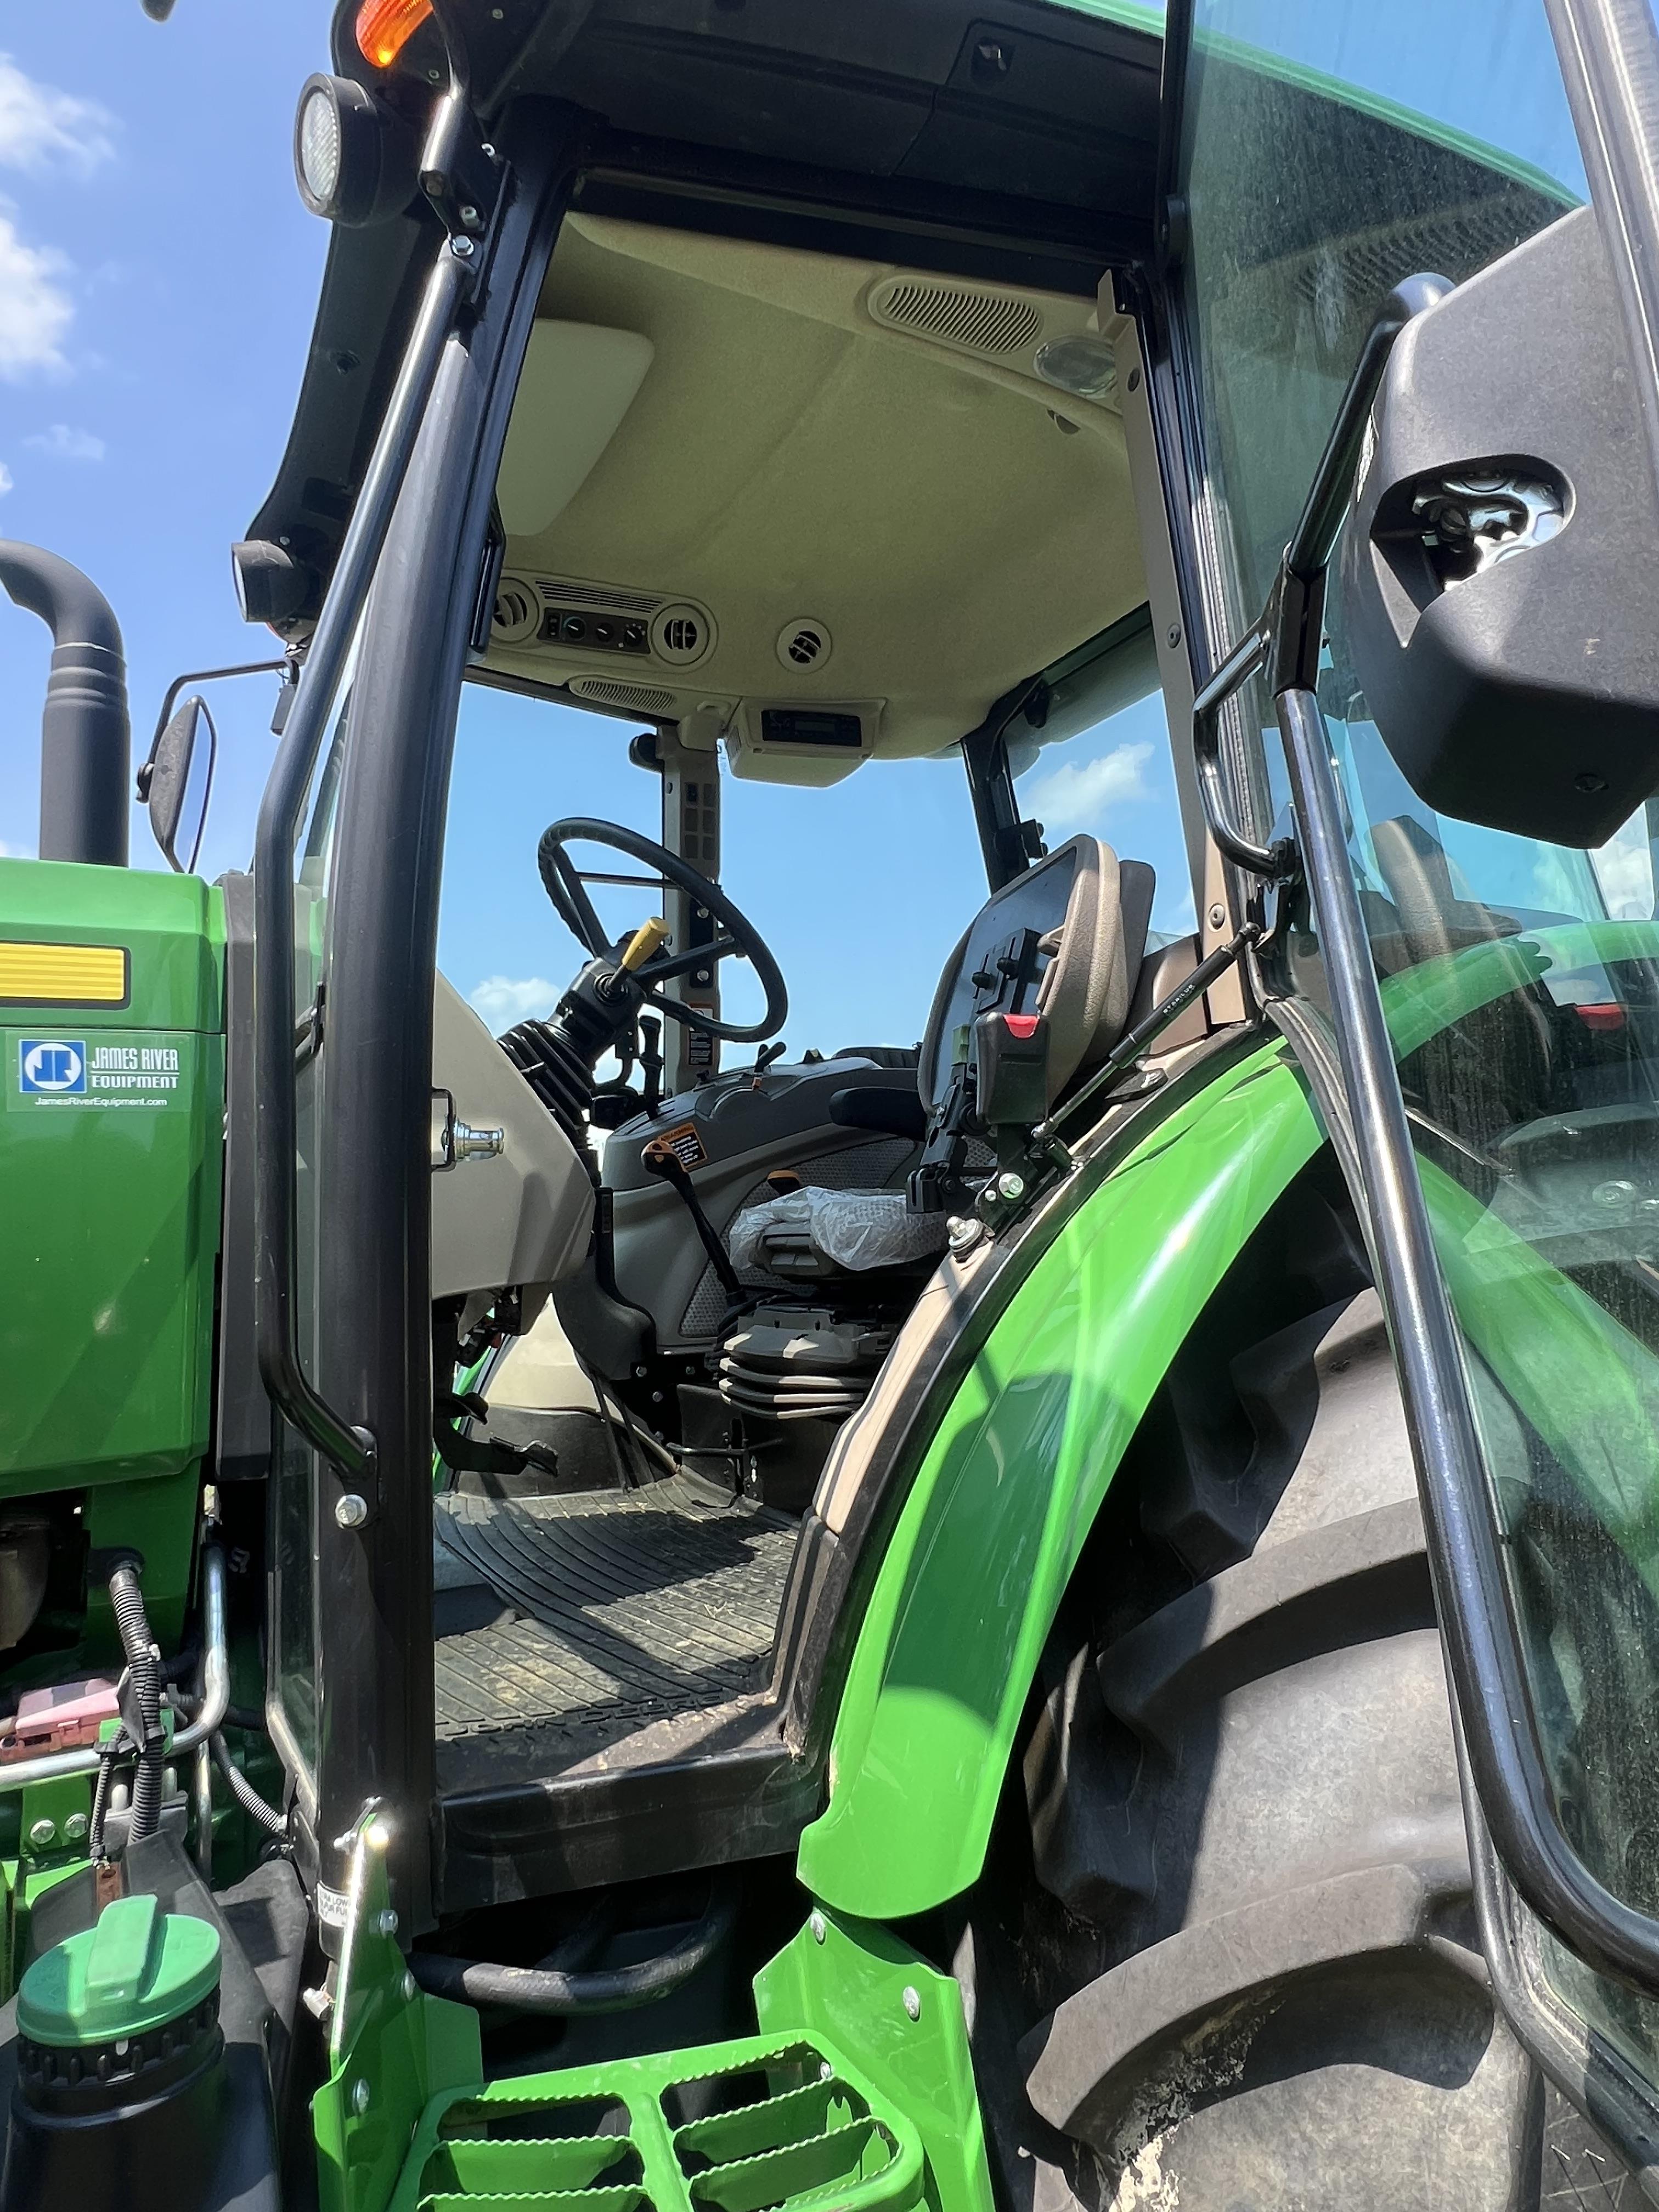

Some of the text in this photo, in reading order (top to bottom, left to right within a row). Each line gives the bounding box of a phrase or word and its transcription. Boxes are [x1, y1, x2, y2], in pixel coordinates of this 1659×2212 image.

[92, 1047, 179, 1070] JAMES RIVER
[92, 1075, 179, 1088] EQUIPMENT
[35, 1097, 168, 1107] JamesRiverEquipment.com
